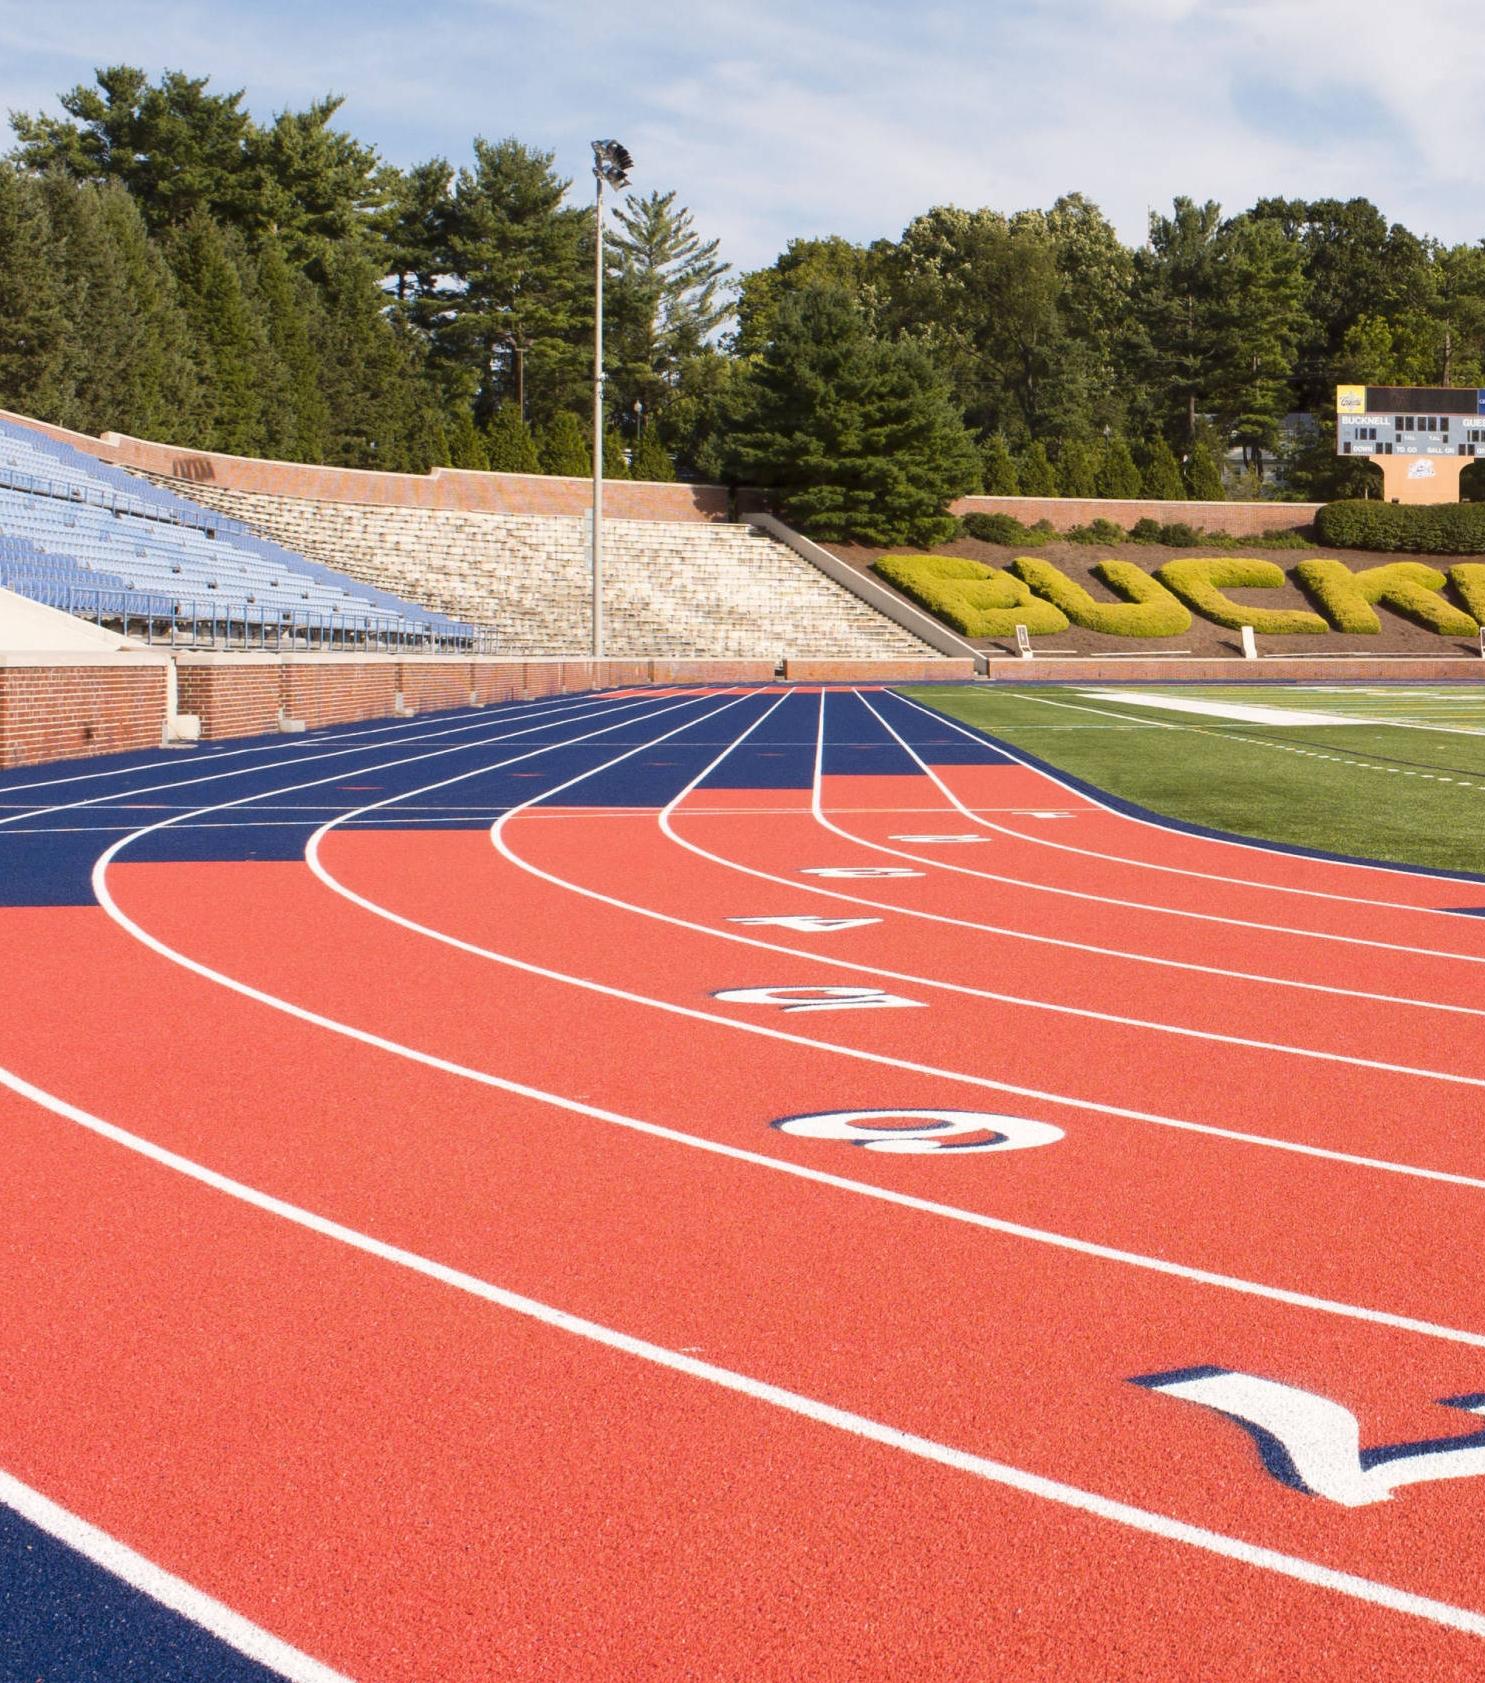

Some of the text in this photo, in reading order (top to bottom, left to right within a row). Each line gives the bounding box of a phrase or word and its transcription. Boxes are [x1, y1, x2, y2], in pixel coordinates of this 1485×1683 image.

[1341, 415, 1391, 425] BUCKNELL
[1011, 811, 1077, 819] 1
[887, 834, 992, 843] 2
[797, 867, 926, 878] 3
[725, 915, 884, 933] 4
[706, 985, 930, 1013] 5
